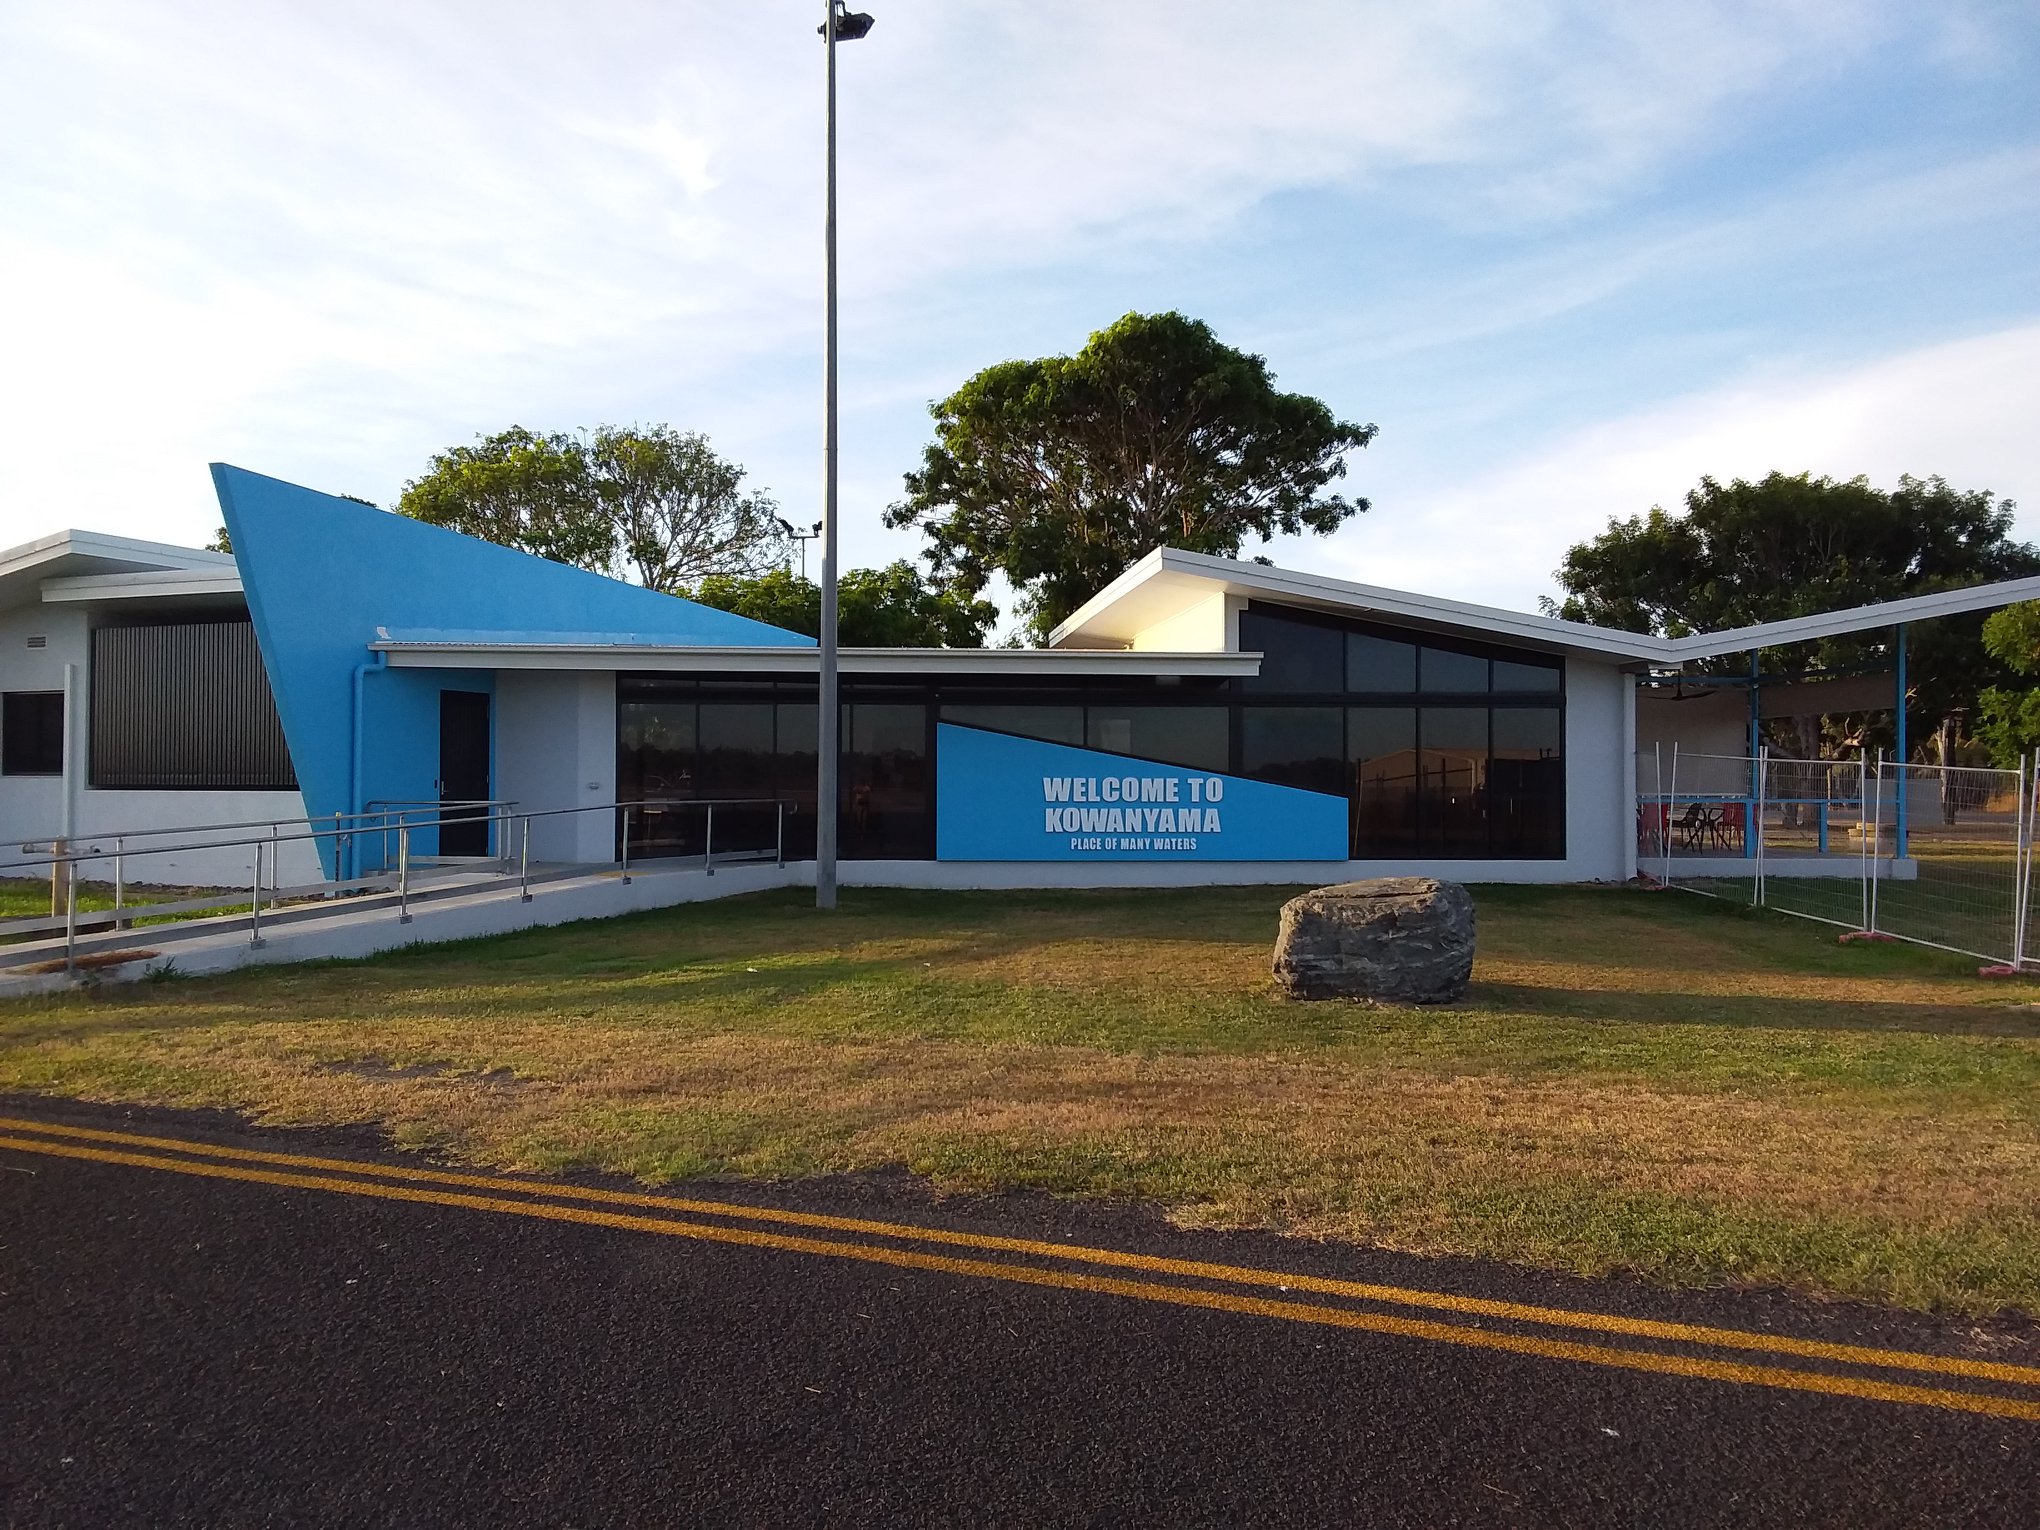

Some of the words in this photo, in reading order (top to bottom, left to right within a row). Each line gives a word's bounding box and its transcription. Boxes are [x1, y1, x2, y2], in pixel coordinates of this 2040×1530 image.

[1043, 777, 1179, 802] WELCOME
[1187, 777, 1223, 802] TO
[1045, 807, 1221, 832] KOWANYAMA
[1071, 837, 1102, 850] PLACE
[1105, 837, 1117, 850] OF
[1120, 837, 1151, 850] MANY
[1153, 837, 1197, 850] WATERS
